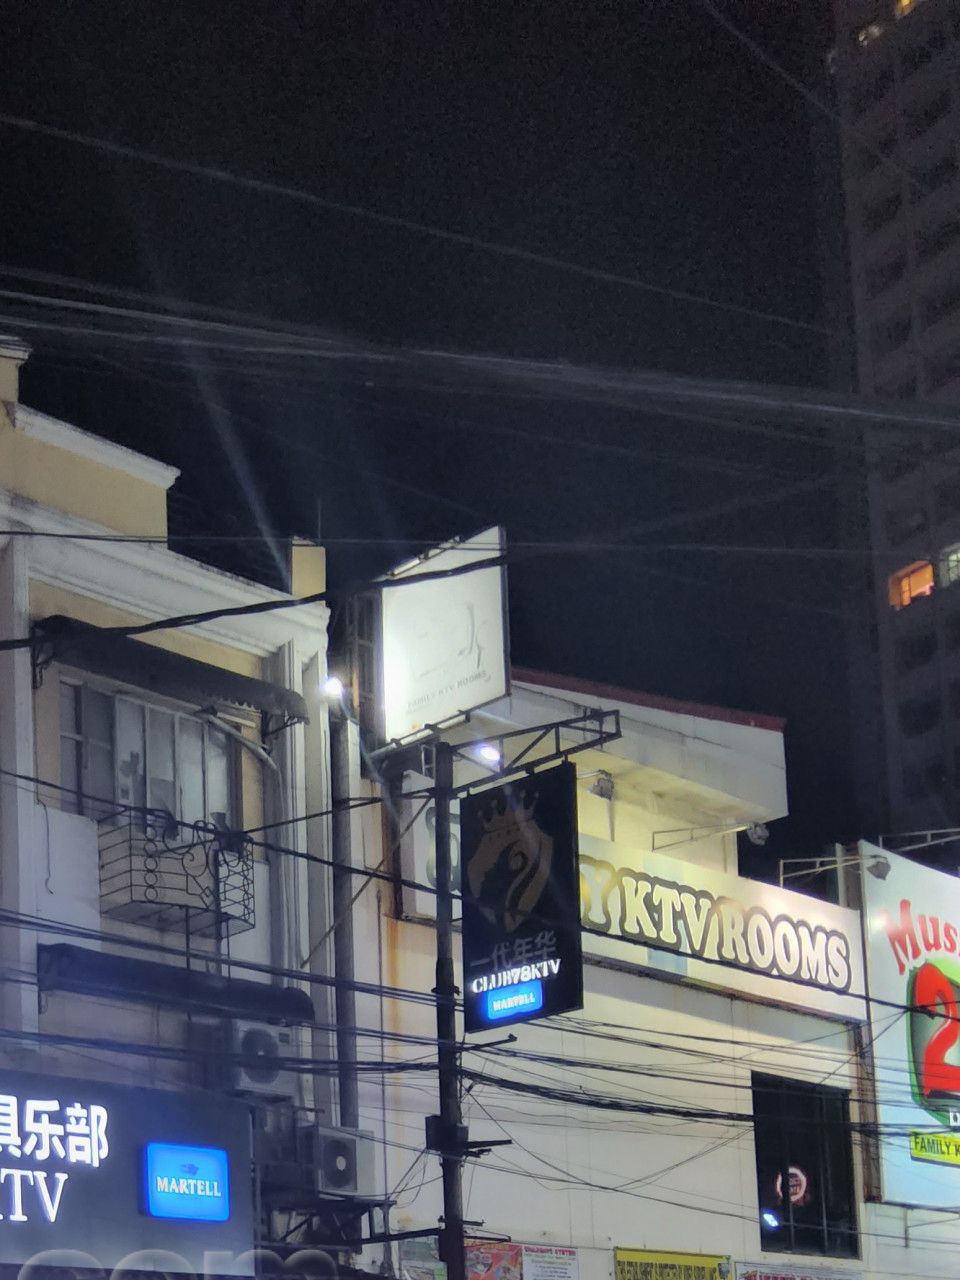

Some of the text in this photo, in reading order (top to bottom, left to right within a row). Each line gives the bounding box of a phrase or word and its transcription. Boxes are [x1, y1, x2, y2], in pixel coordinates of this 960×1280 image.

[886, 898, 960, 976] Mus
[472, 958, 561, 993] CLUB78KTV
[914, 1136, 951, 1156] FAMILY
[156, 1175, 222, 1198] MARTELL
